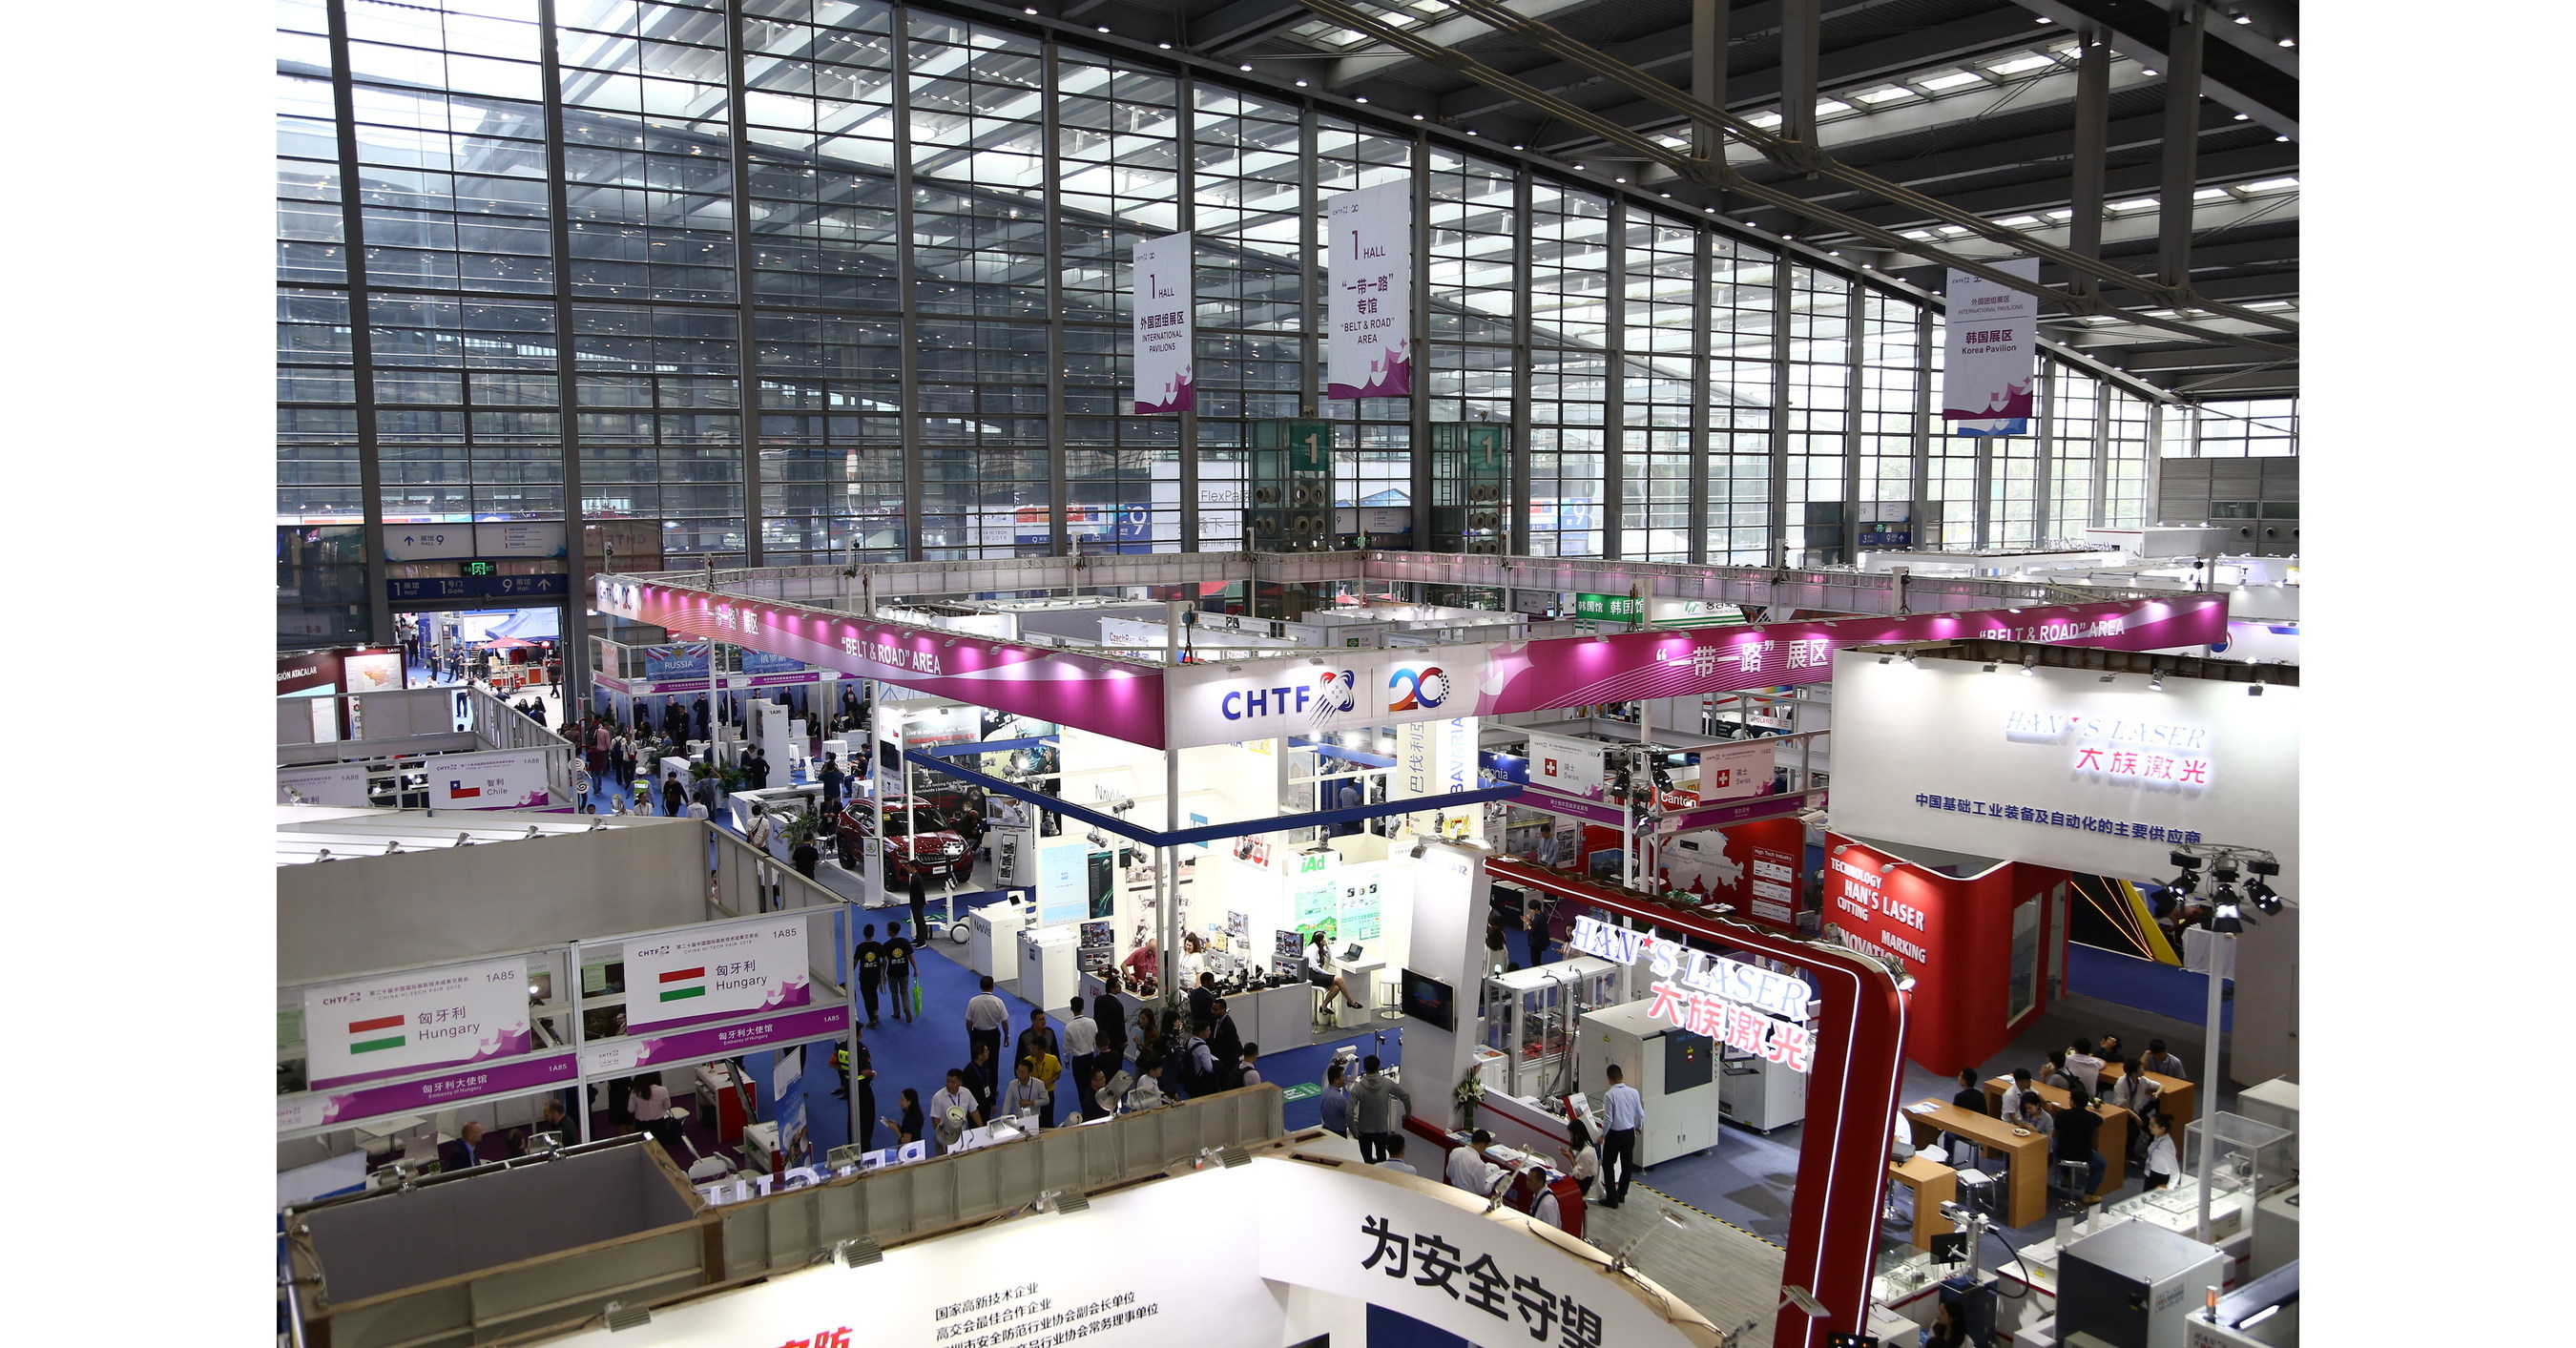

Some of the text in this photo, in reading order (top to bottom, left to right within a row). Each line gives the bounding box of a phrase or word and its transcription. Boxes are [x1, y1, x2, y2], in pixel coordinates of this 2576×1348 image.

[1352, 230, 1385, 260] 1 HALL
[1150, 274, 1174, 300] 1 HALL
[1342, 273, 1394, 295] “一带一路”
[1357, 298, 1378, 315] 专馆
[1971, 296, 2009, 305] 外国团组展区
[1958, 306, 1996, 315] INTERNATIONAL
[1141, 311, 1185, 330] 外国团组展区
[1363, 321, 1369, 330] &
[1142, 330, 1183, 342] INTERNATIONAL
[1358, 334, 1378, 344] AREA
[1965, 328, 2013, 344] 韩国展区
[1149, 342, 1175, 353] PAVILIONS
[1962, 344, 2017, 355] Korea Pavilion
[1305, 434, 1318, 464] 1
[1483, 436, 1493, 465] 1
[1129, 506, 1147, 535] 9
[1573, 500, 1586, 525] 9
[436, 534, 445, 546] 9
[1862, 534, 1867, 544] 3
[1886, 534, 1891, 543] 9
[393, 582, 401, 595] 1
[439, 580, 447, 593] 1
[502, 578, 512, 592] 9
[1578, 601, 1605, 613] 韩国馆
[2026, 628, 2036, 642] &
[2040, 622, 2086, 643] ROAD”
[2088, 619, 2125, 637] AREA
[841, 636, 943, 675] “BELT & ROAD” AREA
[292, 666, 317, 677] ATACALAR
[664, 660, 694, 670] RUSSIA
[1389, 666, 1450, 712] 20
[1221, 683, 1311, 721] CHTF
[2109, 720, 2207, 750] LASER
[1450, 717, 1464, 794] BAVARIA
[2074, 747, 2209, 785] 大族激光
[487, 778, 505, 788] 智利
[1564, 772, 1579, 781] Swiss
[1736, 777, 1752, 786] Swiss
[487, 786, 508, 796] Chile
[300, 796, 320, 805] 智利
[1915, 792, 2202, 845] 中国基础工业装备及自动化的主要供应商
[1300, 855, 1325, 874] iAd
[1831, 857, 1882, 890] TECHNOLOGY
[1837, 896, 1869, 923] CUTTING
[1844, 879, 1925, 932] HAN'S LASER
[676, 933, 759, 950] 第二十届中国国际高新技术成果交易会
[773, 927, 798, 939] 1A85
[637, 948, 658, 958] CHTF
[1880, 929, 1927, 964] MARKING
[486, 970, 515, 983] 1A85
[716, 960, 756, 977] 匈牙利
[369, 977, 469, 996] 第二十届中国国际高新技术成果交易会
[716, 975, 769, 991] Hungary
[1682, 951, 1806, 1020] LASER
[322, 995, 348, 1006] CHTF
[378, 992, 399, 1001] CHINA
[401, 988, 427, 998] HI-TECH
[418, 1006, 467, 1025] 匈牙利
[823, 1014, 840, 1023] 1A85
[418, 1021, 481, 1041] Hungary
[717, 1024, 773, 1042] 匈牙利大使馆
[1648, 983, 1806, 1072] 大族激光
[723, 1036, 744, 1046] Embassy
[750, 1033, 769, 1043] Hungary
[549, 1063, 568, 1072] 1A85
[422, 1074, 488, 1093] 匈牙利大使馆
[428, 1089, 454, 1099] Embassy
[460, 1085, 483, 1095] Hungary
[1361, 1213, 1602, 1348] 为安全守望
[935, 1281, 1039, 1322] 国家高新技术企业
[935, 1297, 1051, 1342] 高交会最佳合作企业
